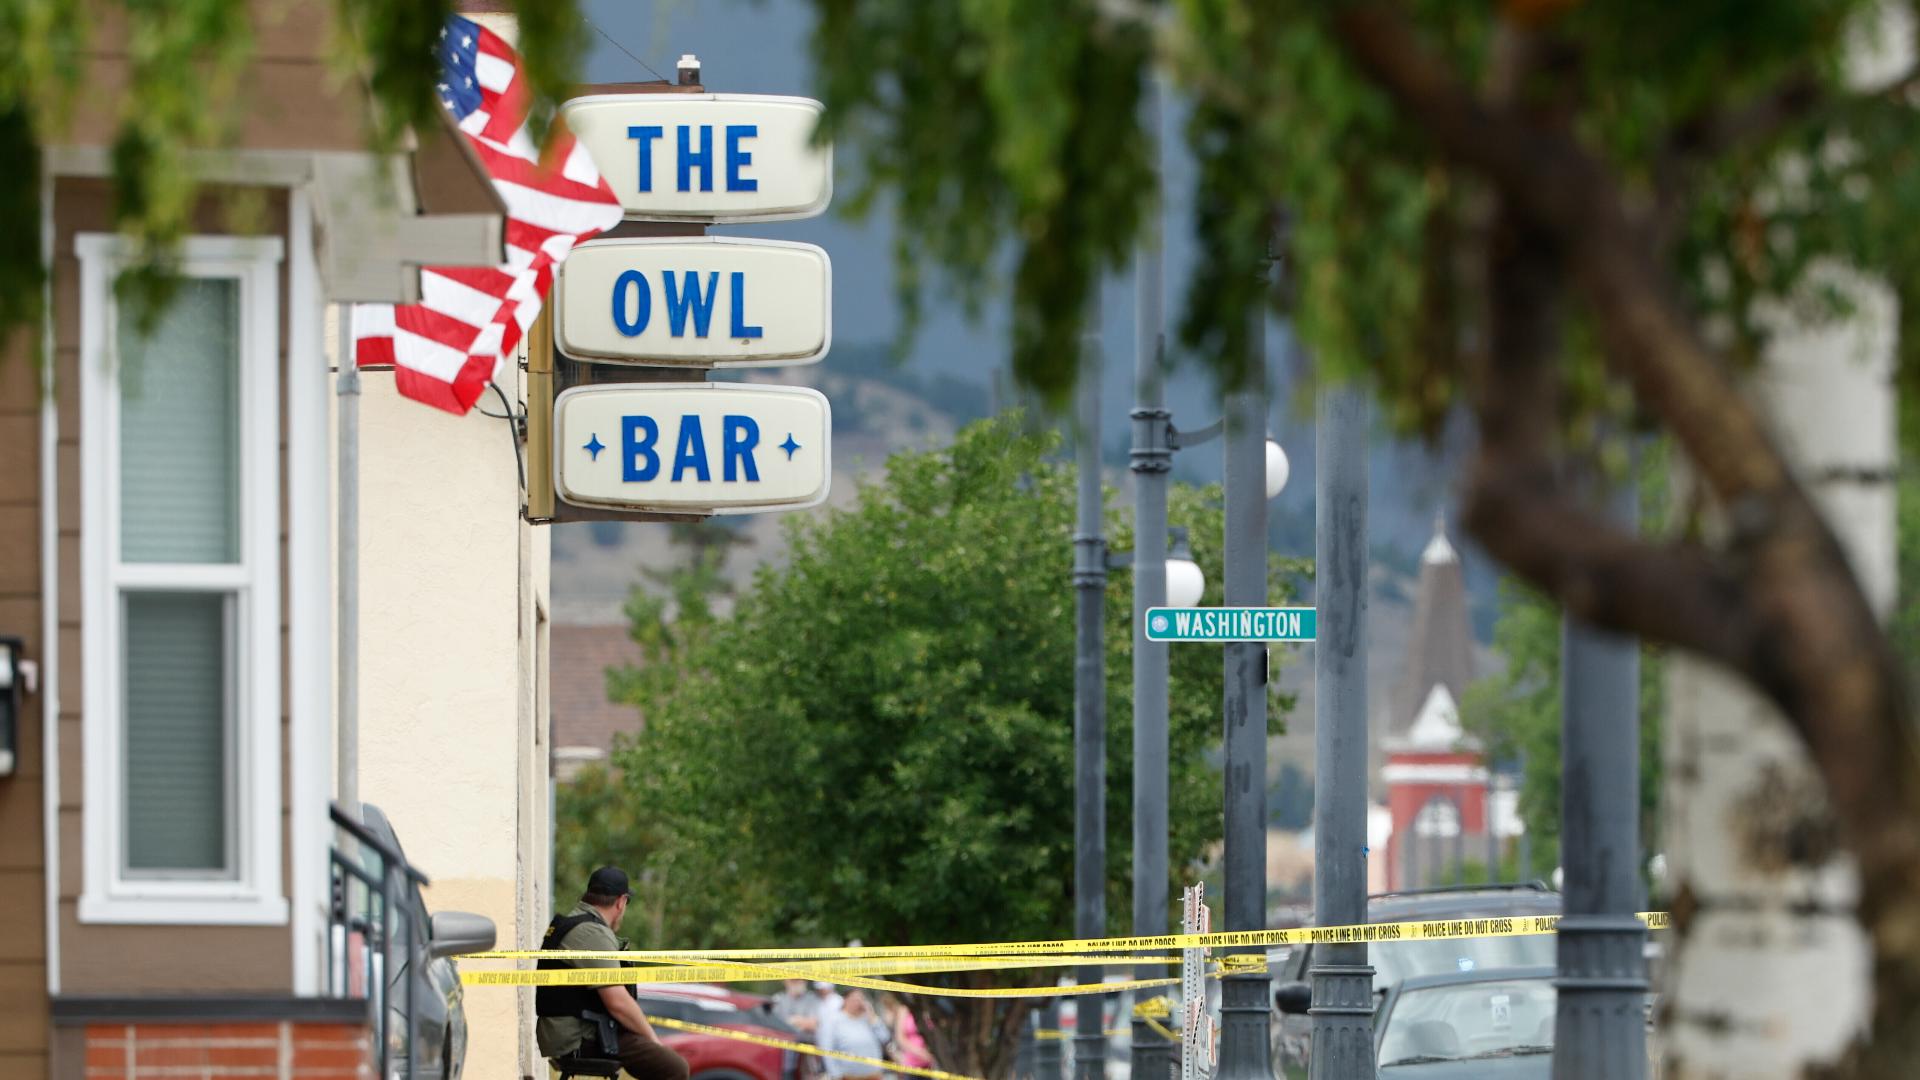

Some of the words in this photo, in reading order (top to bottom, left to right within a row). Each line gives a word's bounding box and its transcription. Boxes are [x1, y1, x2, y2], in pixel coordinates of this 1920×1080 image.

[627, 125, 758, 193] THE
[612, 269, 763, 338] OWL
[621, 415, 760, 482] BAR
[1175, 612, 1300, 637] WASHINGTON
[1311, 930, 1334, 943] POLICE
[1336, 928, 1350, 942] LINE
[1353, 928, 1362, 941] DO
[1364, 926, 1376, 940] NOT
[1379, 924, 1401, 939] CROSS
[1423, 922, 1446, 937] POLICE
[1448, 921, 1463, 936] LINE
[1465, 921, 1474, 934] DO
[1476, 920, 1488, 934] NOT
[1490, 918, 1513, 933] CROSS
